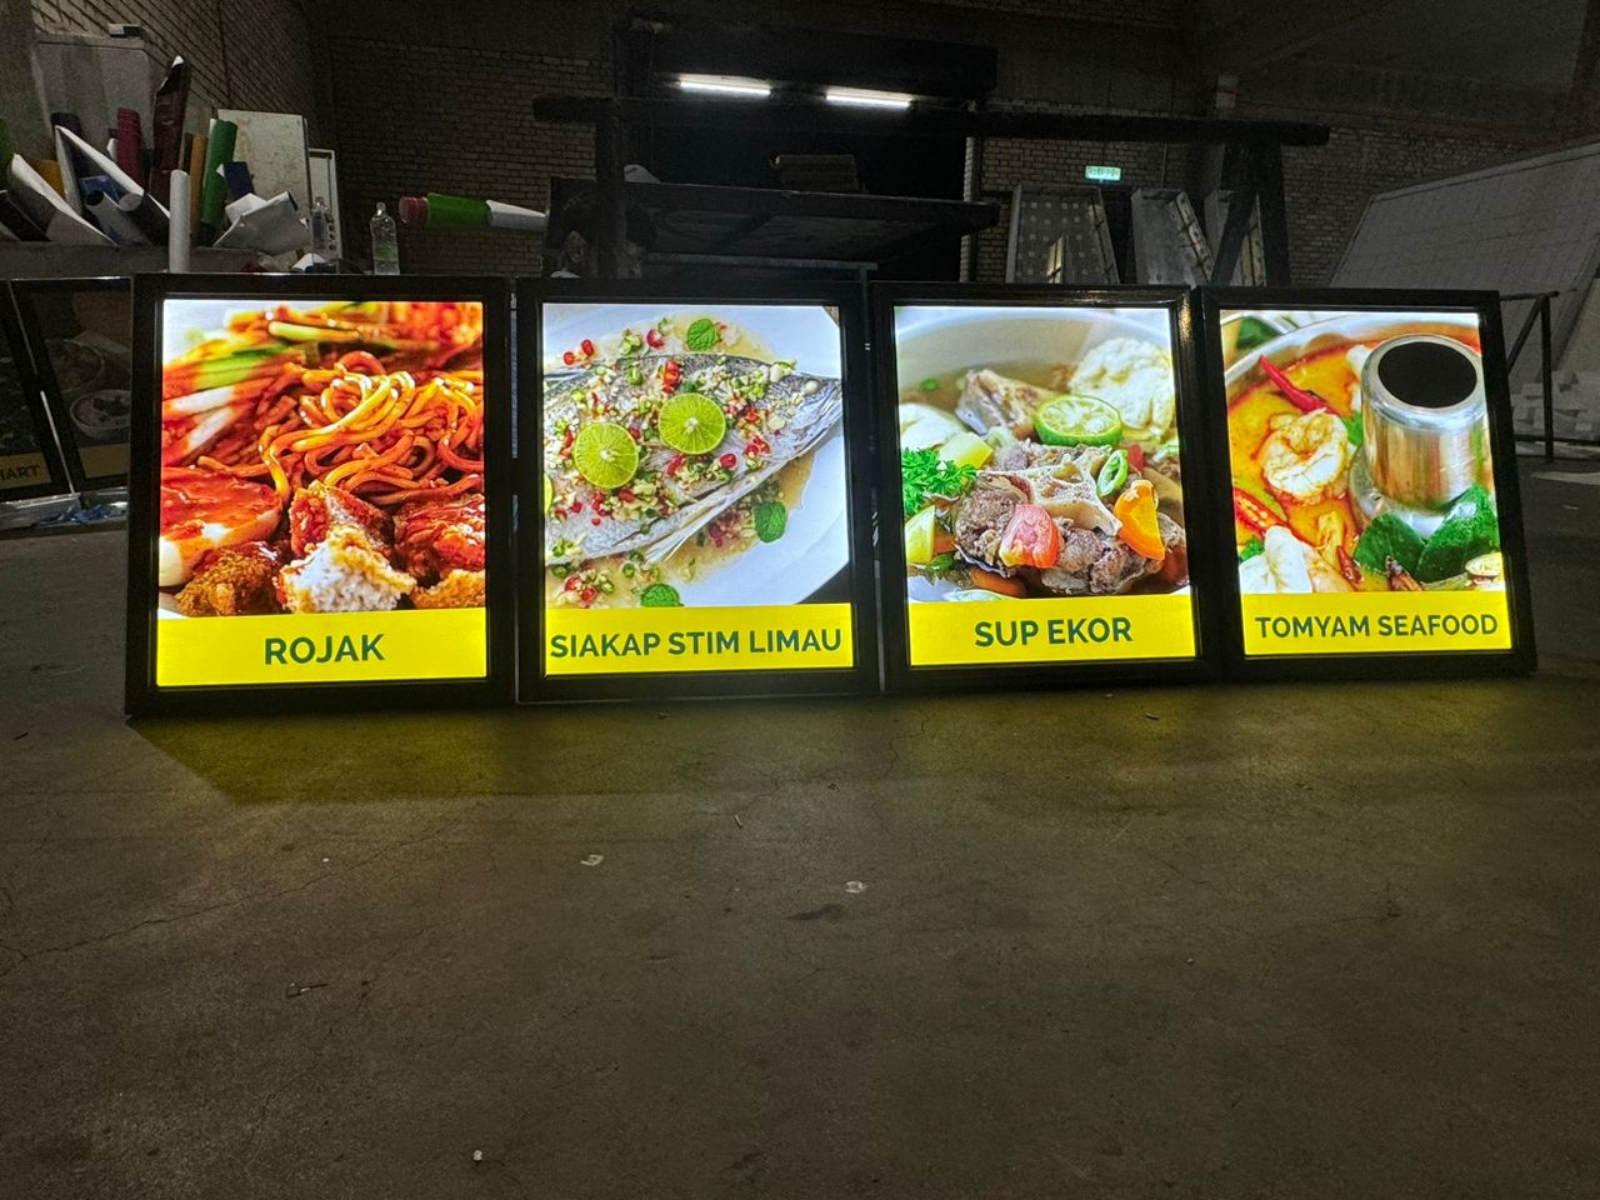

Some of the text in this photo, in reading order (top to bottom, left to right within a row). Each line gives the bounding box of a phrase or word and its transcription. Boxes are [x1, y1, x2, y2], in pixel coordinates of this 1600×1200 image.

[974, 617, 1132, 647] SUP EKOR
[1255, 614, 1497, 638] TOMYAM SEAFOOD
[265, 635, 384, 665] ROJAK
[551, 629, 841, 658] SIAKAP STIM LIMAU
